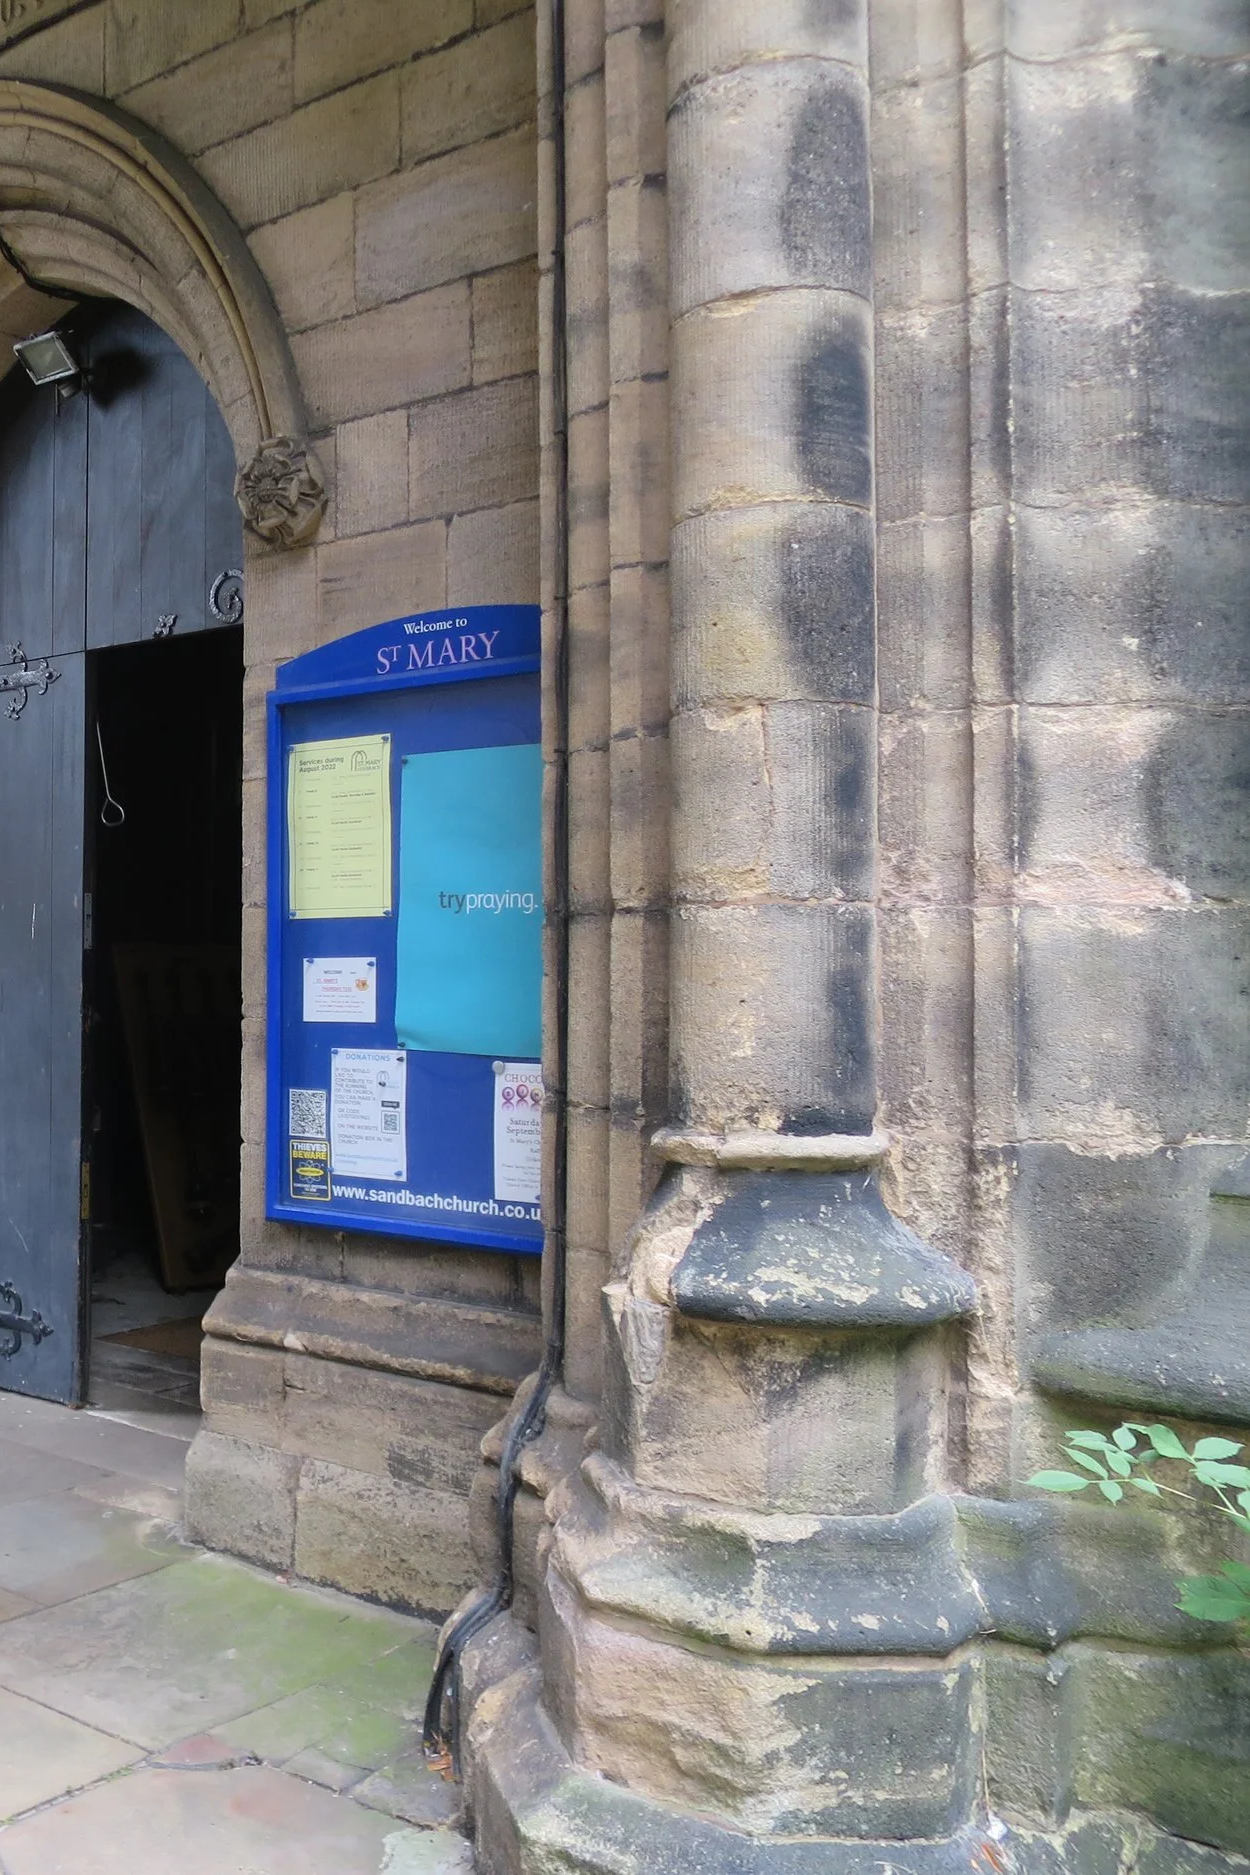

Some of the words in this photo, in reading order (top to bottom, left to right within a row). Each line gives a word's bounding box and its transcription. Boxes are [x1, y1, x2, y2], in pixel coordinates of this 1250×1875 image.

[403, 620, 453, 634] Welcome
[455, 618, 468, 628] to
[406, 630, 500, 670] MARY
[299, 758, 324, 767] Services
[299, 765, 319, 773] August
[321, 763, 336, 771] 2022
[346, 1053, 391, 1062] DONATIONS
[293, 1142, 327, 1152] THIEVES
[293, 1151, 327, 1160] BEWARE
